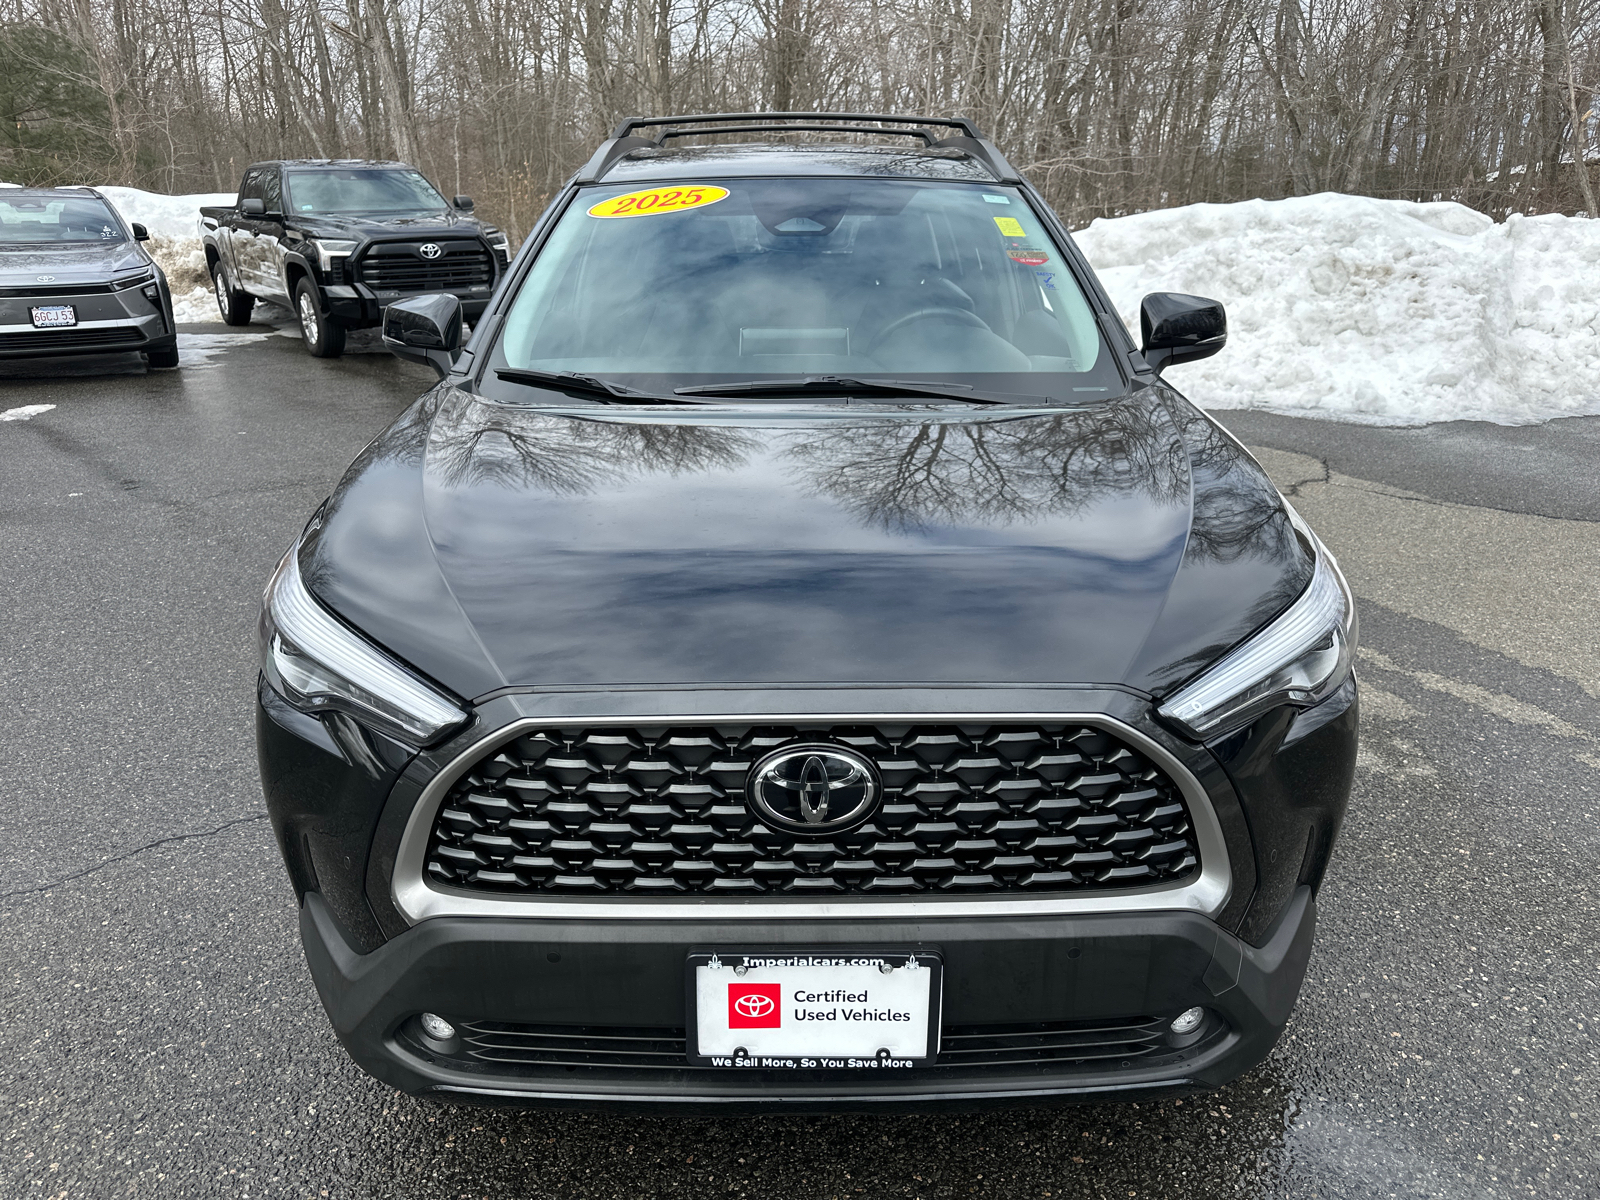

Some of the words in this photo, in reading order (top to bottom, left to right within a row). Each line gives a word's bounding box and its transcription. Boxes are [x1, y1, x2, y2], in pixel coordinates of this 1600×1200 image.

[611, 188, 706, 215] 2025
[34, 311, 59, 322] 6GCJ
[61, 310, 74, 320] 53
[742, 956, 885, 968] Imperialcars.com
[794, 990, 868, 1003] Certified
[794, 1008, 837, 1021] Used
[841, 1008, 911, 1022] Vehicles
[711, 1057, 732, 1067] We
[735, 1057, 758, 1067] Sell
[762, 1057, 797, 1069] More,
[800, 1058, 817, 1068] So
[820, 1058, 845, 1068] You
[847, 1058, 878, 1068] Save
[881, 1058, 913, 1068] More
